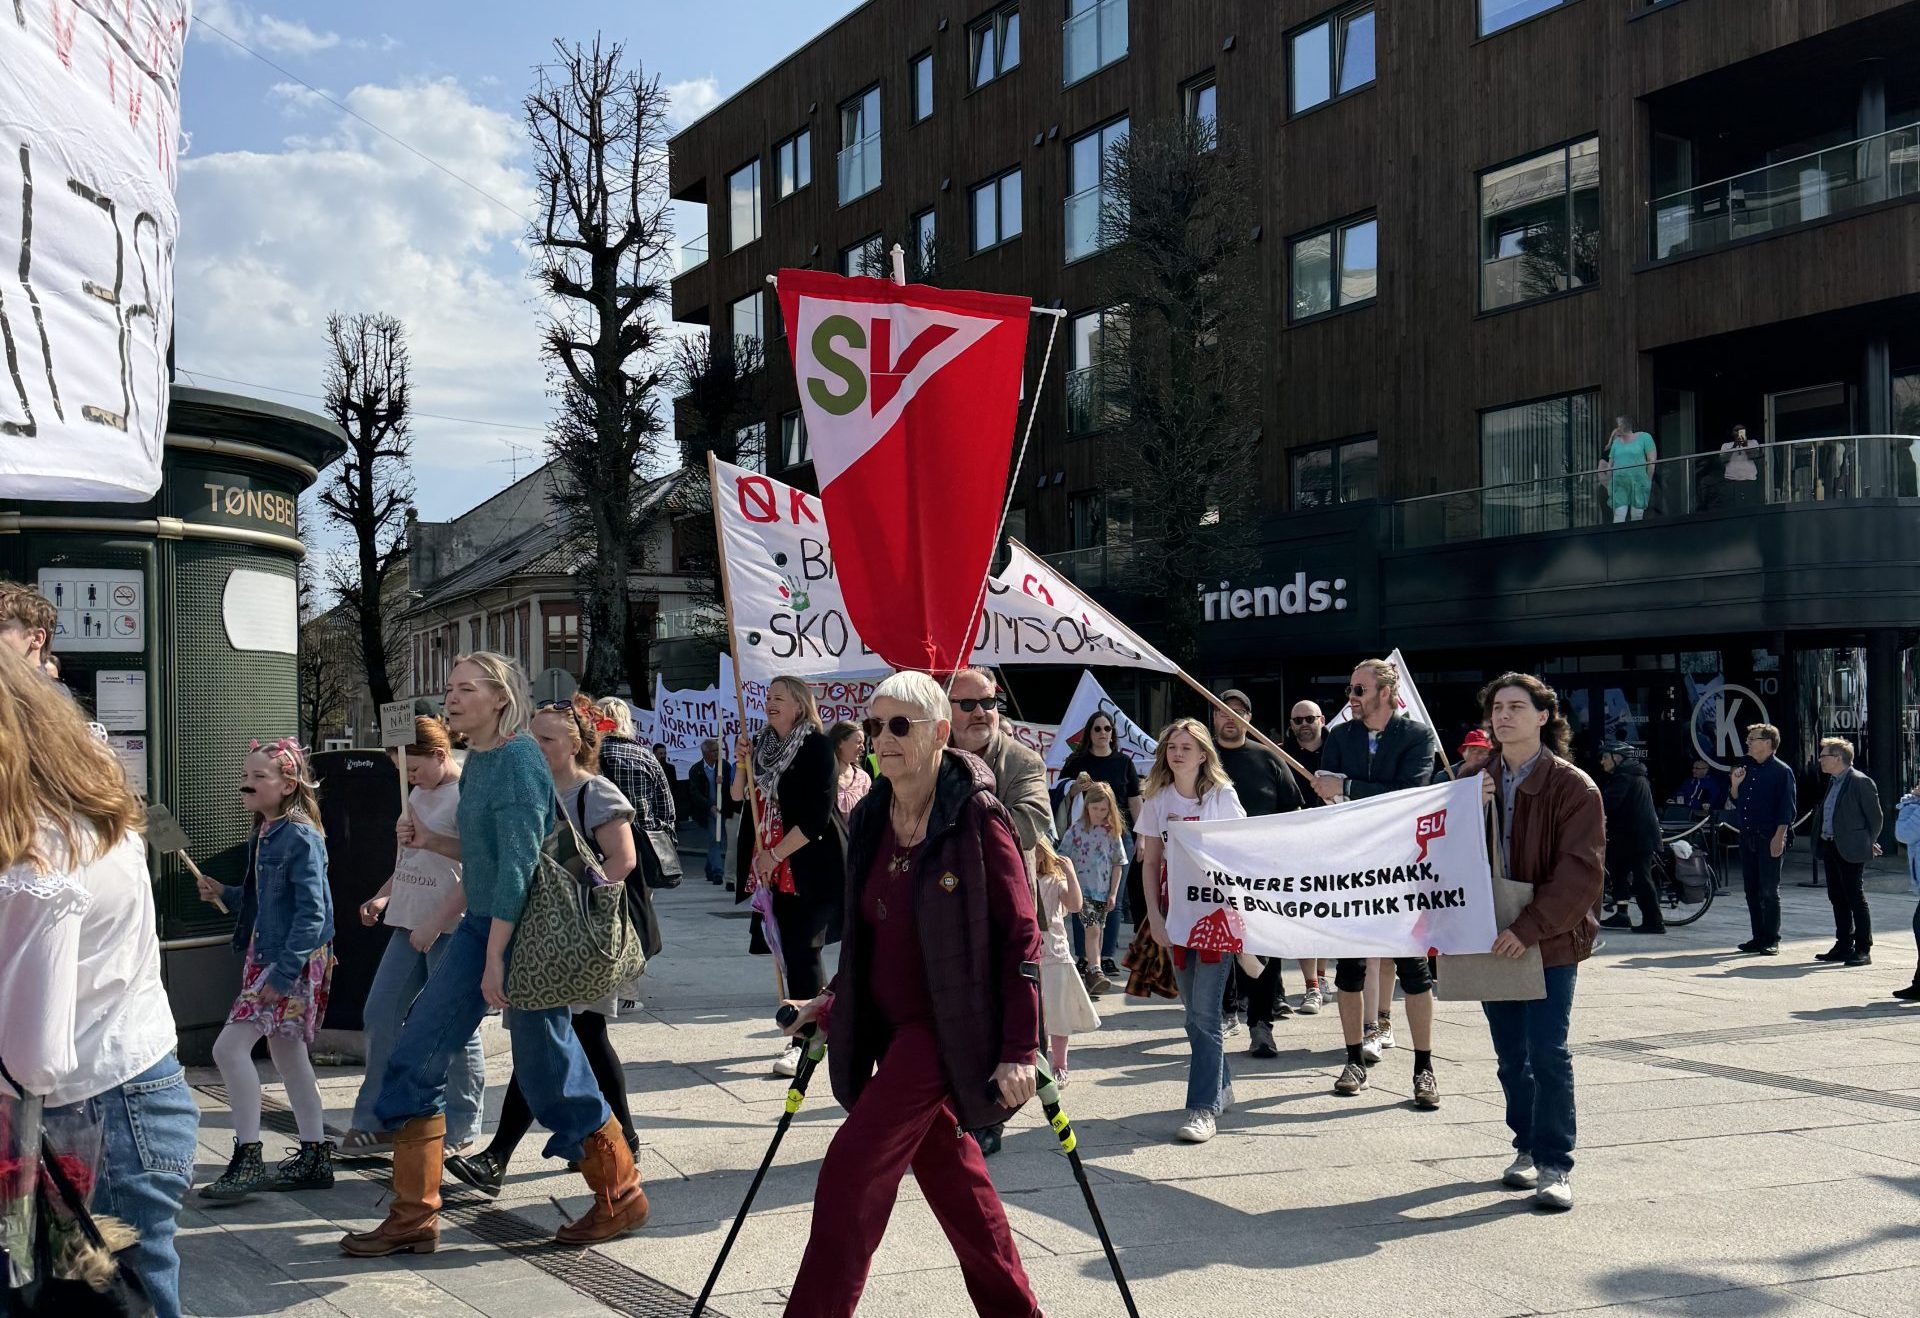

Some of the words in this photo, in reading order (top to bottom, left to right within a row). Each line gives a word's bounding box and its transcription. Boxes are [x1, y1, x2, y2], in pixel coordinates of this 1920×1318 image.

[807, 314, 960, 420] SV
[1755, 677, 1779, 695] 10
[1715, 698, 1744, 757] K
[1418, 814, 1444, 836] SU
[1299, 861, 1440, 893] SNIKKSNAKK,
[1187, 885, 1239, 911] BEDE
[1243, 896, 1400, 919] BOLIGPOLITIKK
[1403, 887, 1466, 912] TAKK!
